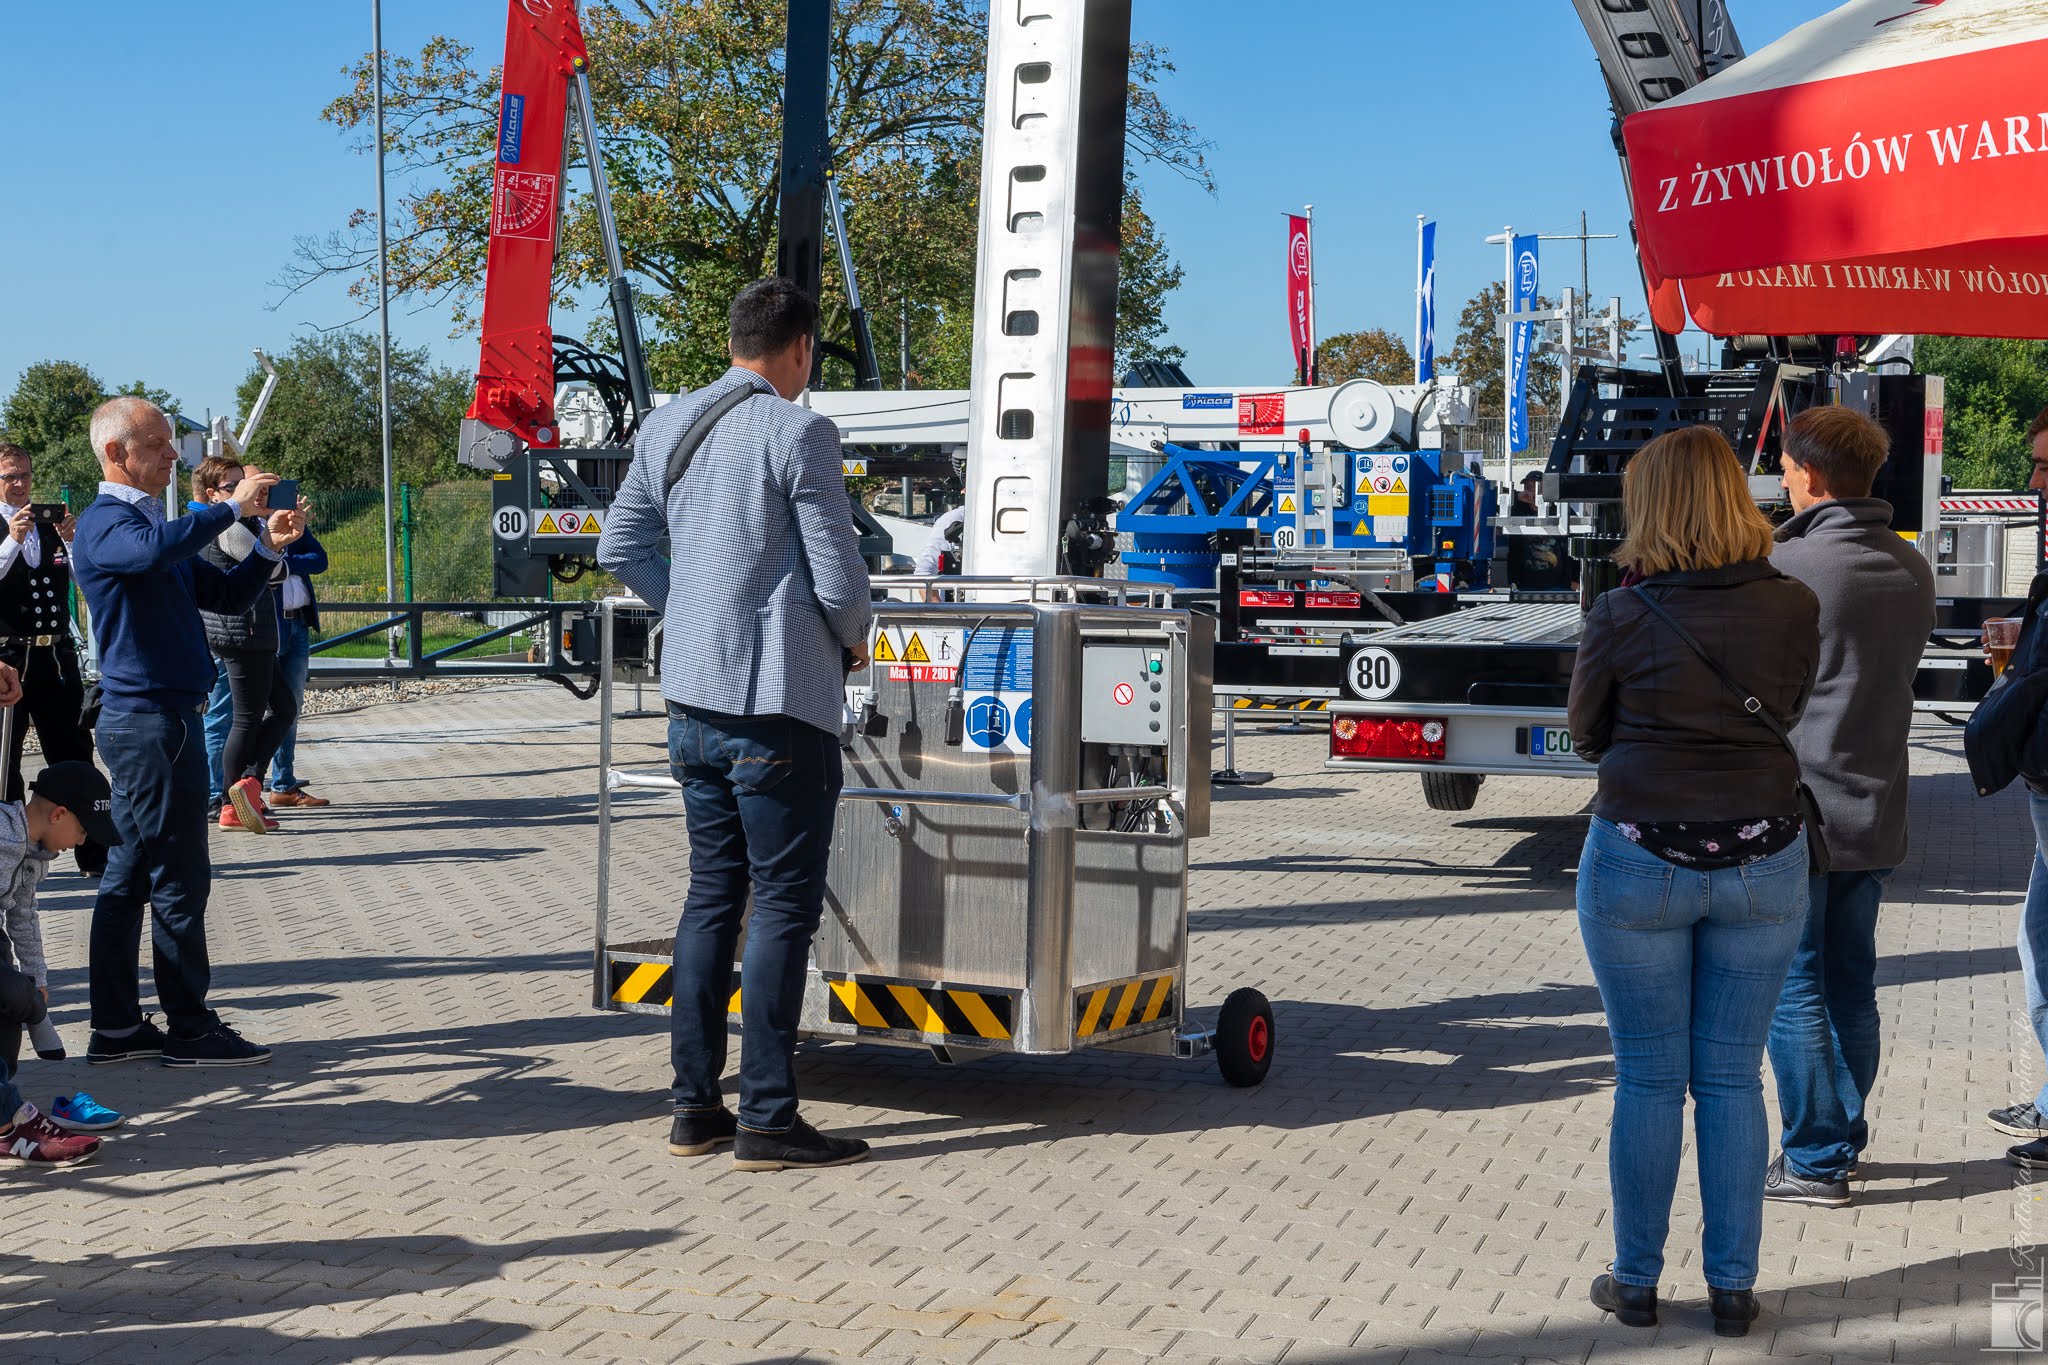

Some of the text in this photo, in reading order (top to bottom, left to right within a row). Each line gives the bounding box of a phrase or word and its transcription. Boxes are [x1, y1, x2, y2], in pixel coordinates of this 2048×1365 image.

[506, 95, 519, 144] Klaas
[1657, 112, 2048, 212] Z ŻYWIOŁÓW WAR
[499, 511, 521, 533] 80
[1278, 530, 1294, 547] 80
[890, 666, 911, 680] Max.
[932, 667, 948, 681] 200
[1356, 656, 1391, 690] 80
[1546, 730, 1571, 753] CO
[93, 799, 111, 811] STR
